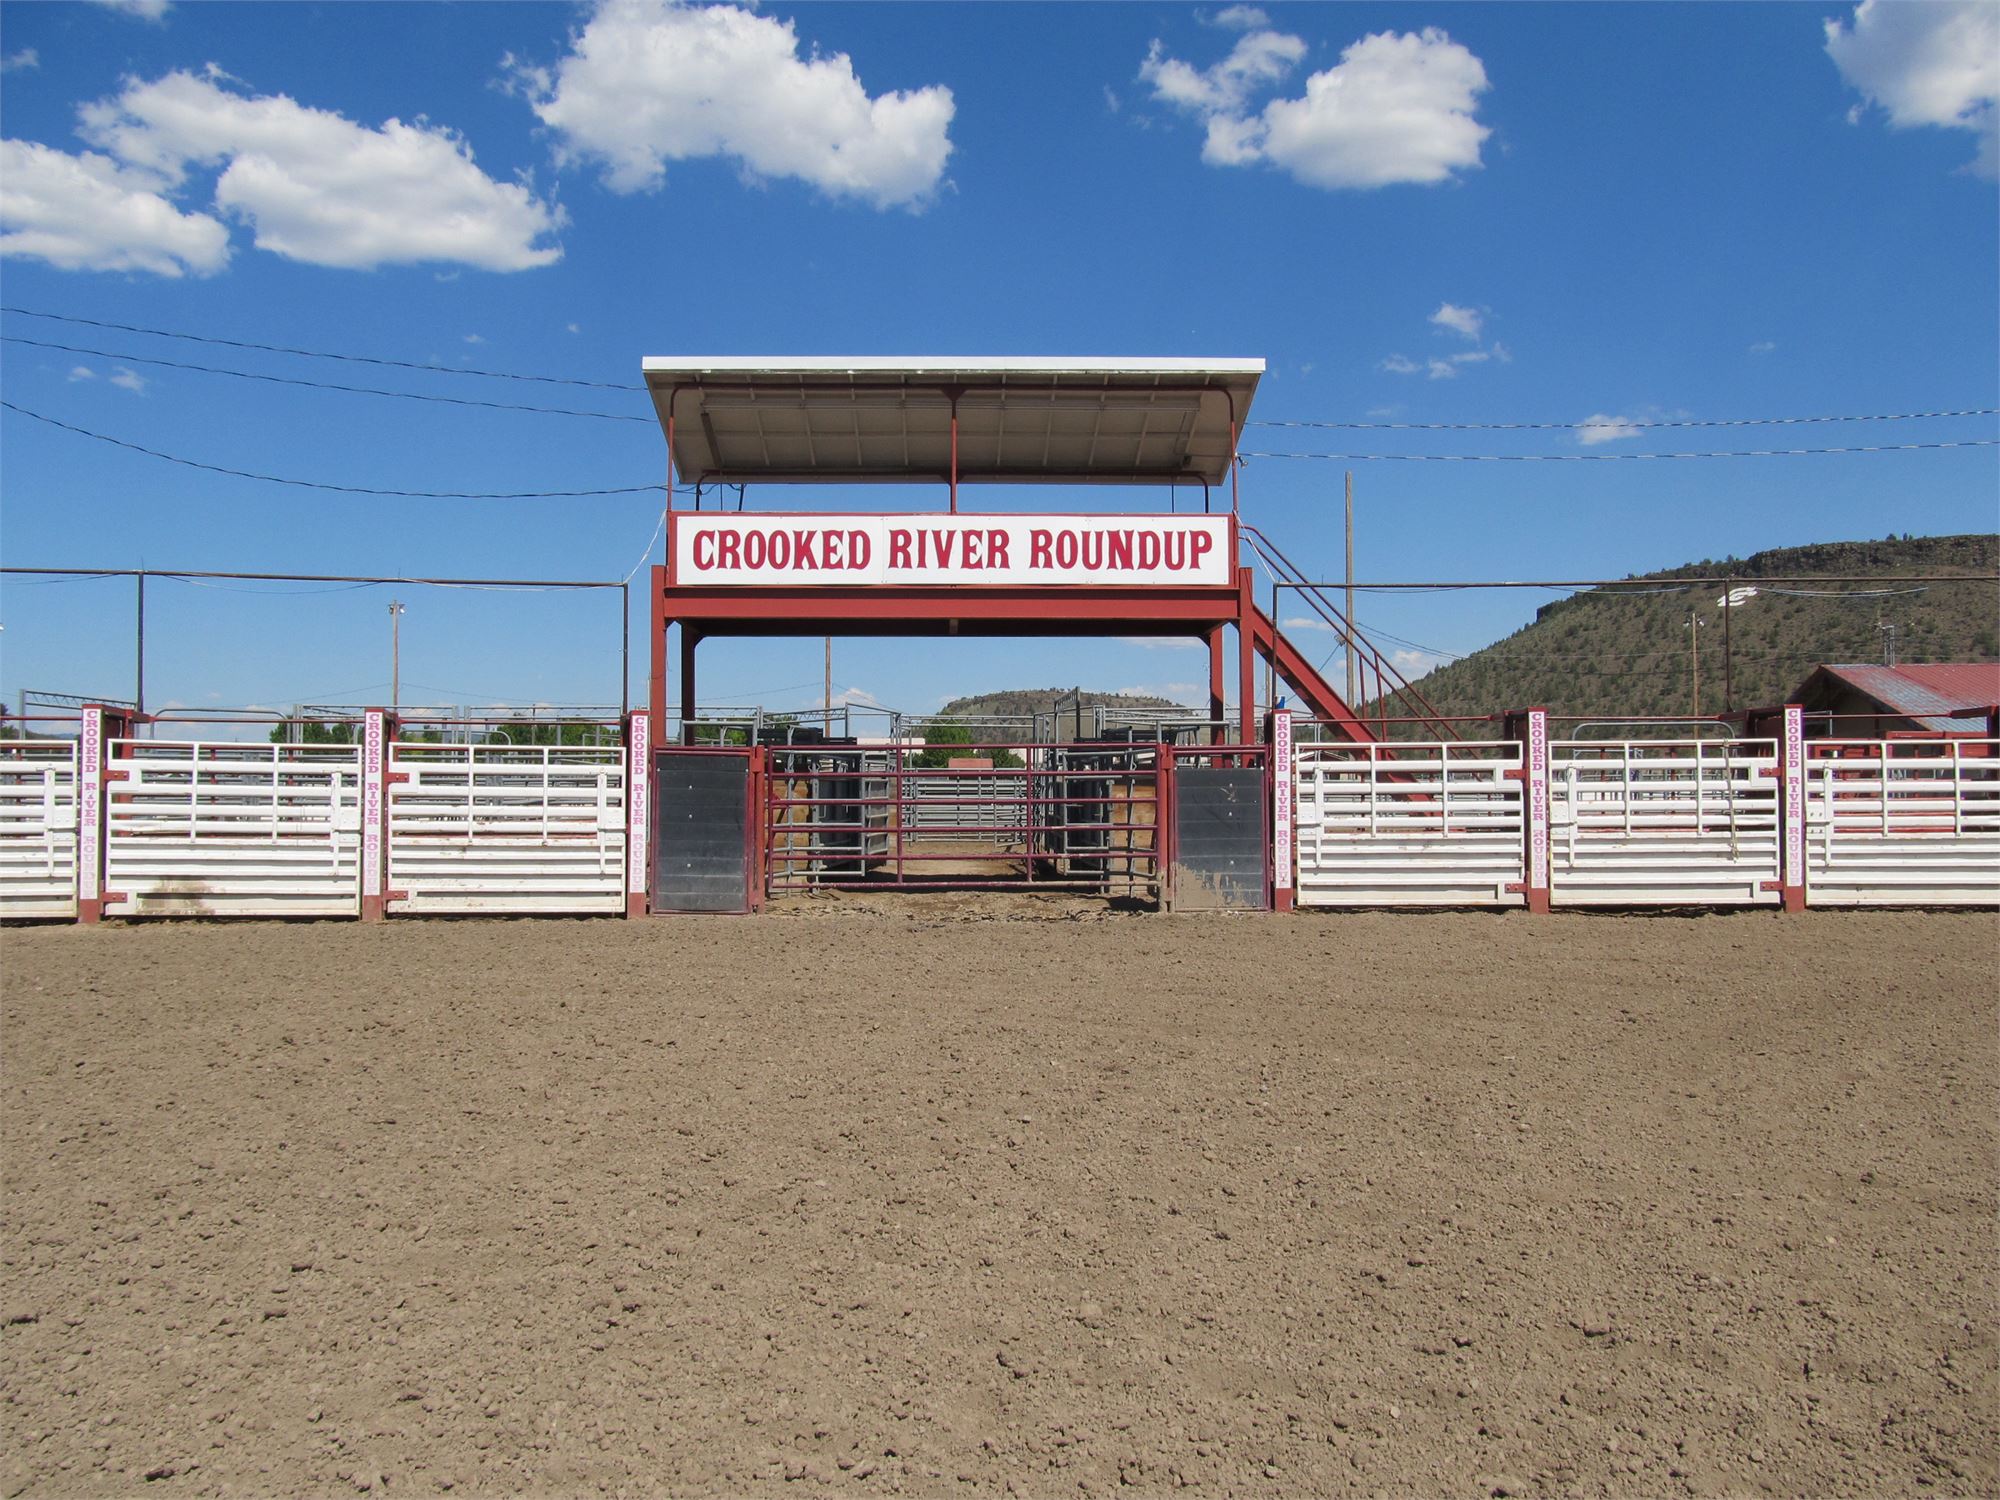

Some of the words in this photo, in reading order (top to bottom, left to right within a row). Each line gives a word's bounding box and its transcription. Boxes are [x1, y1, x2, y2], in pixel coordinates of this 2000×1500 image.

[693, 529, 872, 572] CROOKED
[888, 528, 1010, 570] RIVER
[1029, 529, 1213, 572] ROUNDUP
[85, 710, 98, 773] CROOKED
[367, 713, 380, 774] CROOKED
[633, 717, 645, 775] CROOKED
[1277, 715, 1288, 772] CROOKED
[1531, 713, 1543, 772] CROOKED
[1788, 710, 1800, 768] CROOKED
[84, 782, 98, 827] RIVER
[366, 782, 380, 826] RIVER
[633, 783, 645, 826] RIVER
[1277, 781, 1288, 821] RIVER
[1532, 780, 1544, 821] RIVER
[1788, 777, 1800, 818] RIVER
